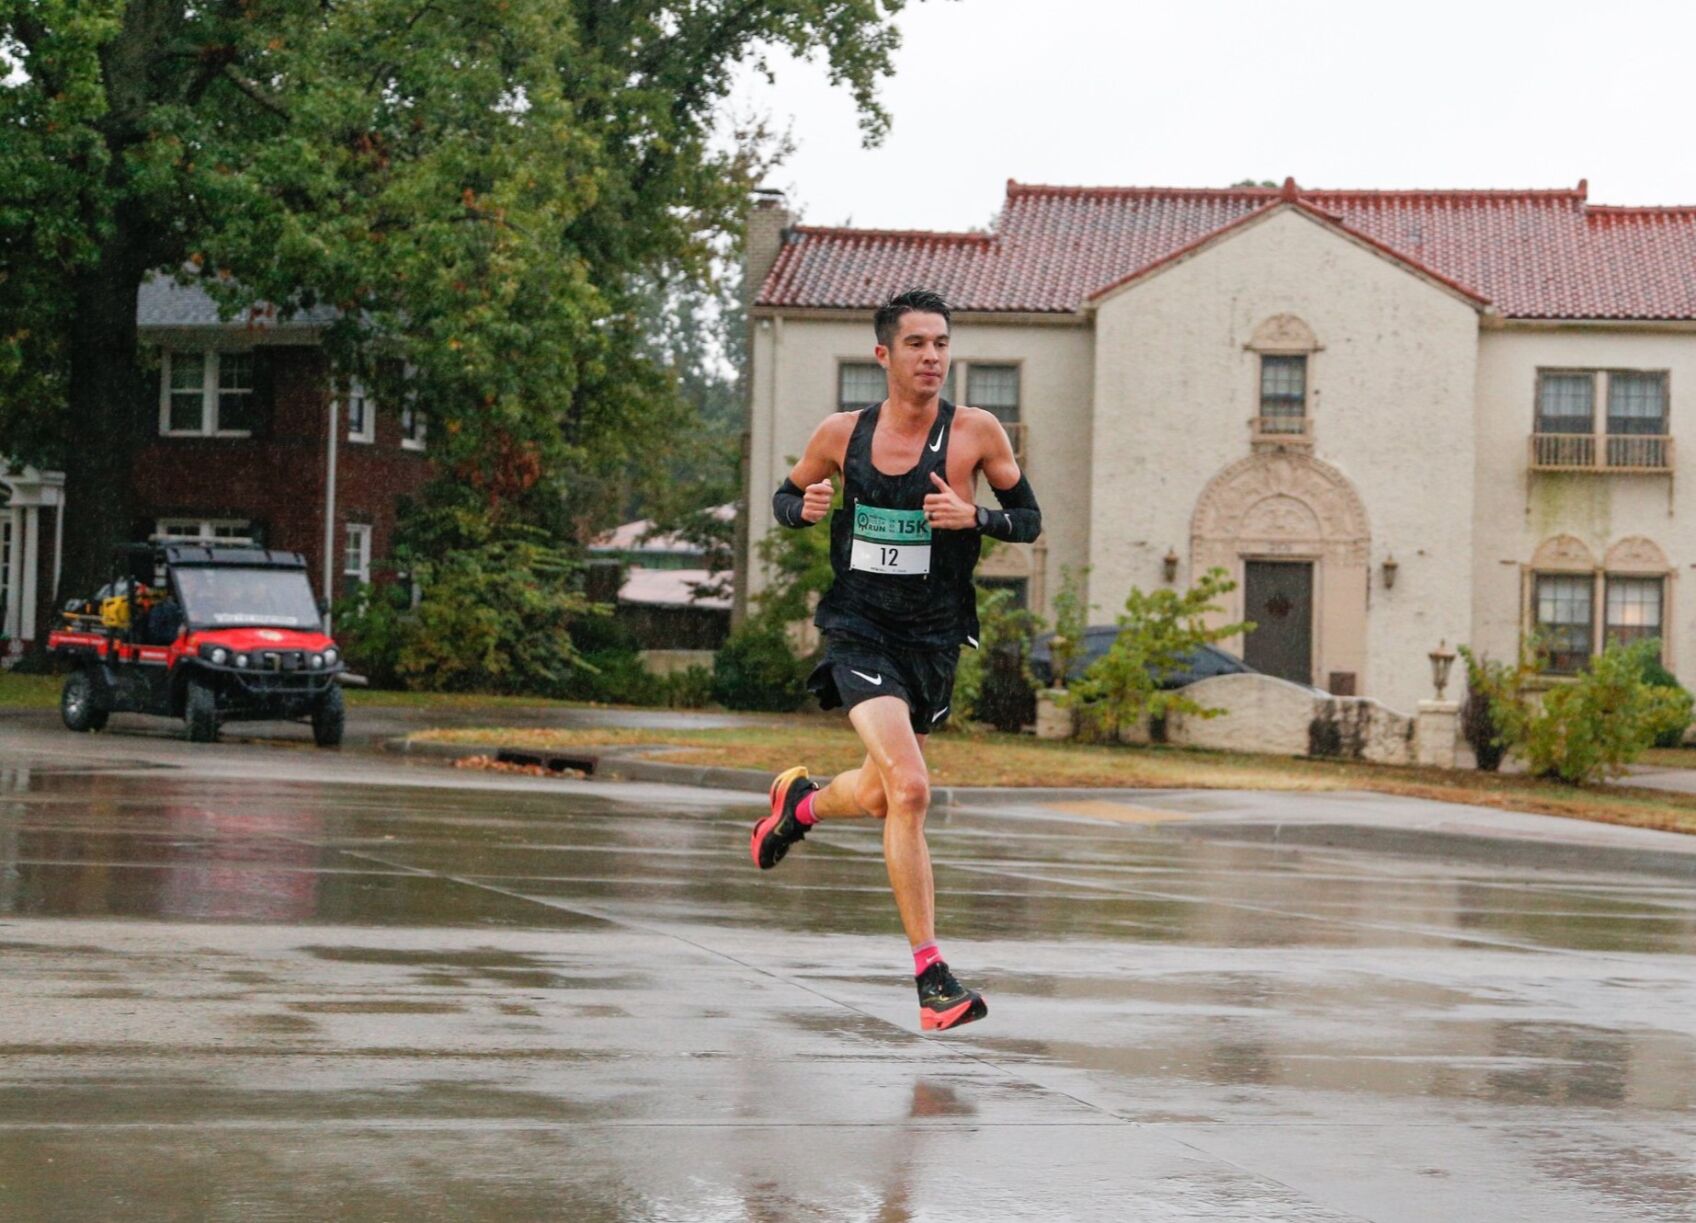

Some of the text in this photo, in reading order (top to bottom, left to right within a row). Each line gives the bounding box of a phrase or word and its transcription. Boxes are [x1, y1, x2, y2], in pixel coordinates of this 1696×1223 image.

[868, 524, 886, 532] RUN
[898, 520, 928, 534] 15K
[880, 547, 899, 566] 12
